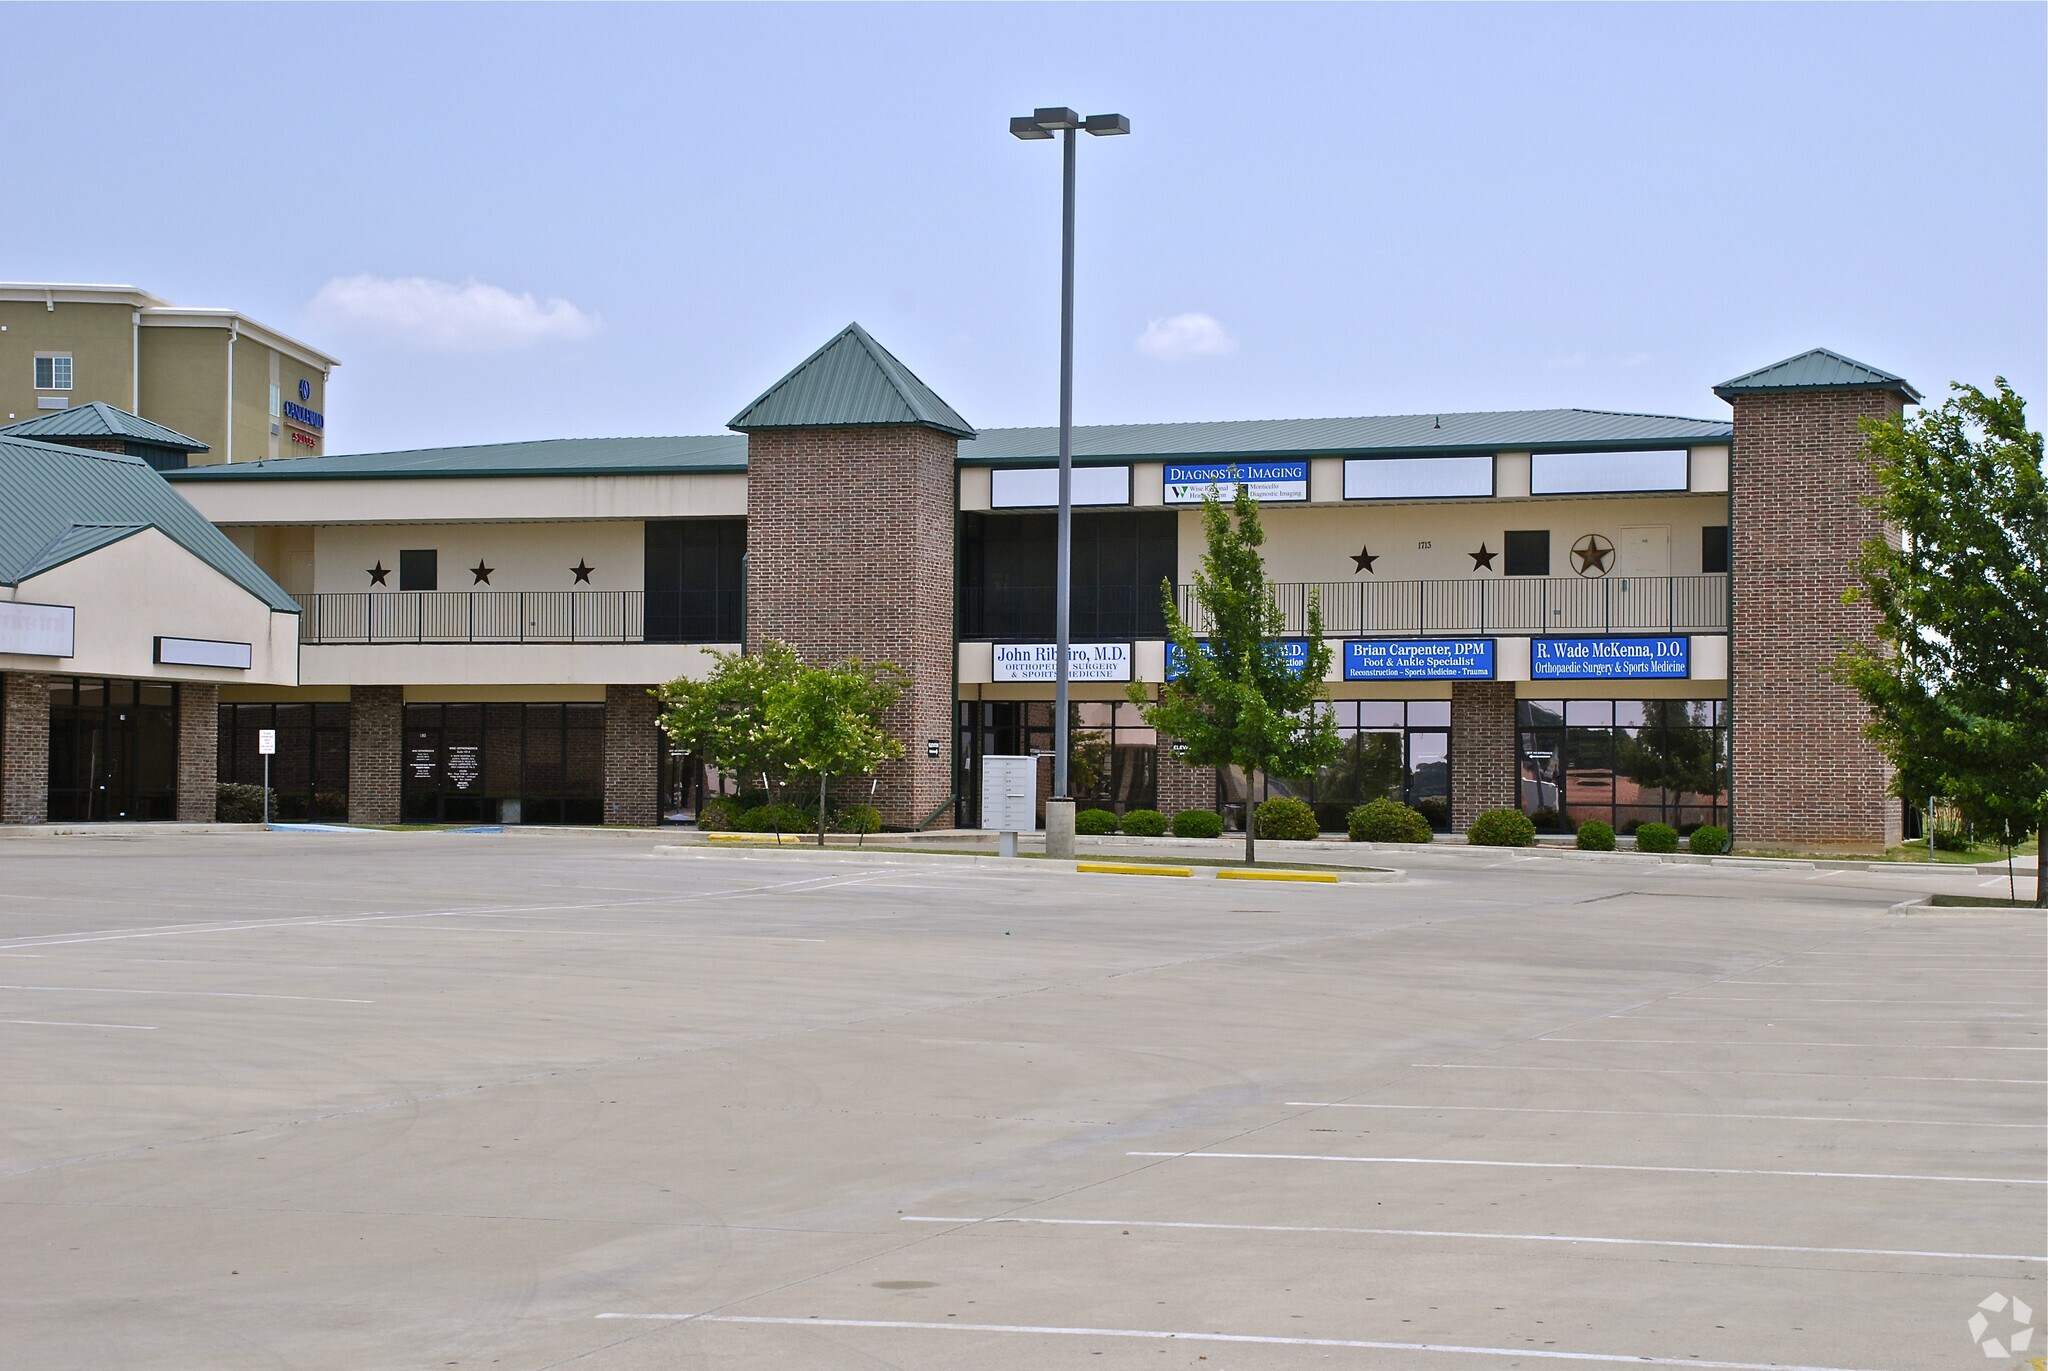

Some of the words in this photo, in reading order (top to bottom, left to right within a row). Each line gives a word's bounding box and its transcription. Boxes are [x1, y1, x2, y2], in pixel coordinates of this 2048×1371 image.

[1247, 466, 1302, 479] IMAGING
[1280, 490, 1302, 498] Imaging
[997, 647, 1031, 661] John
[1036, 647, 1090, 663] Ribiro,
[1094, 646, 1126, 661] M.D.
[1353, 644, 1387, 656] Brian
[1389, 643, 1452, 659] Carpenter,
[1453, 643, 1484, 655] DPM
[1537, 643, 1550, 658] R.
[1553, 642, 1590, 658] Wade
[1592, 642, 1654, 660] McKenna,
[1656, 641, 1683, 657] D.O.
[1363, 657, 1384, 667] Foot
[1386, 657, 1394, 667] &
[1396, 657, 1425, 667] Ankle
[1427, 656, 1475, 668] Specialist
[1535, 661, 1581, 676] Orthopaedic
[1582, 661, 1613, 676] Surgery
[1614, 662, 1622, 673] &
[1623, 660, 1649, 675] Sports
[1650, 660, 1685, 673] Medicine
[1350, 668, 1399, 677] Reconstruction
[1404, 667, 1426, 678] Sports
[1427, 667, 1457, 676] Medicine
[1462, 667, 1489, 676] Trauma
